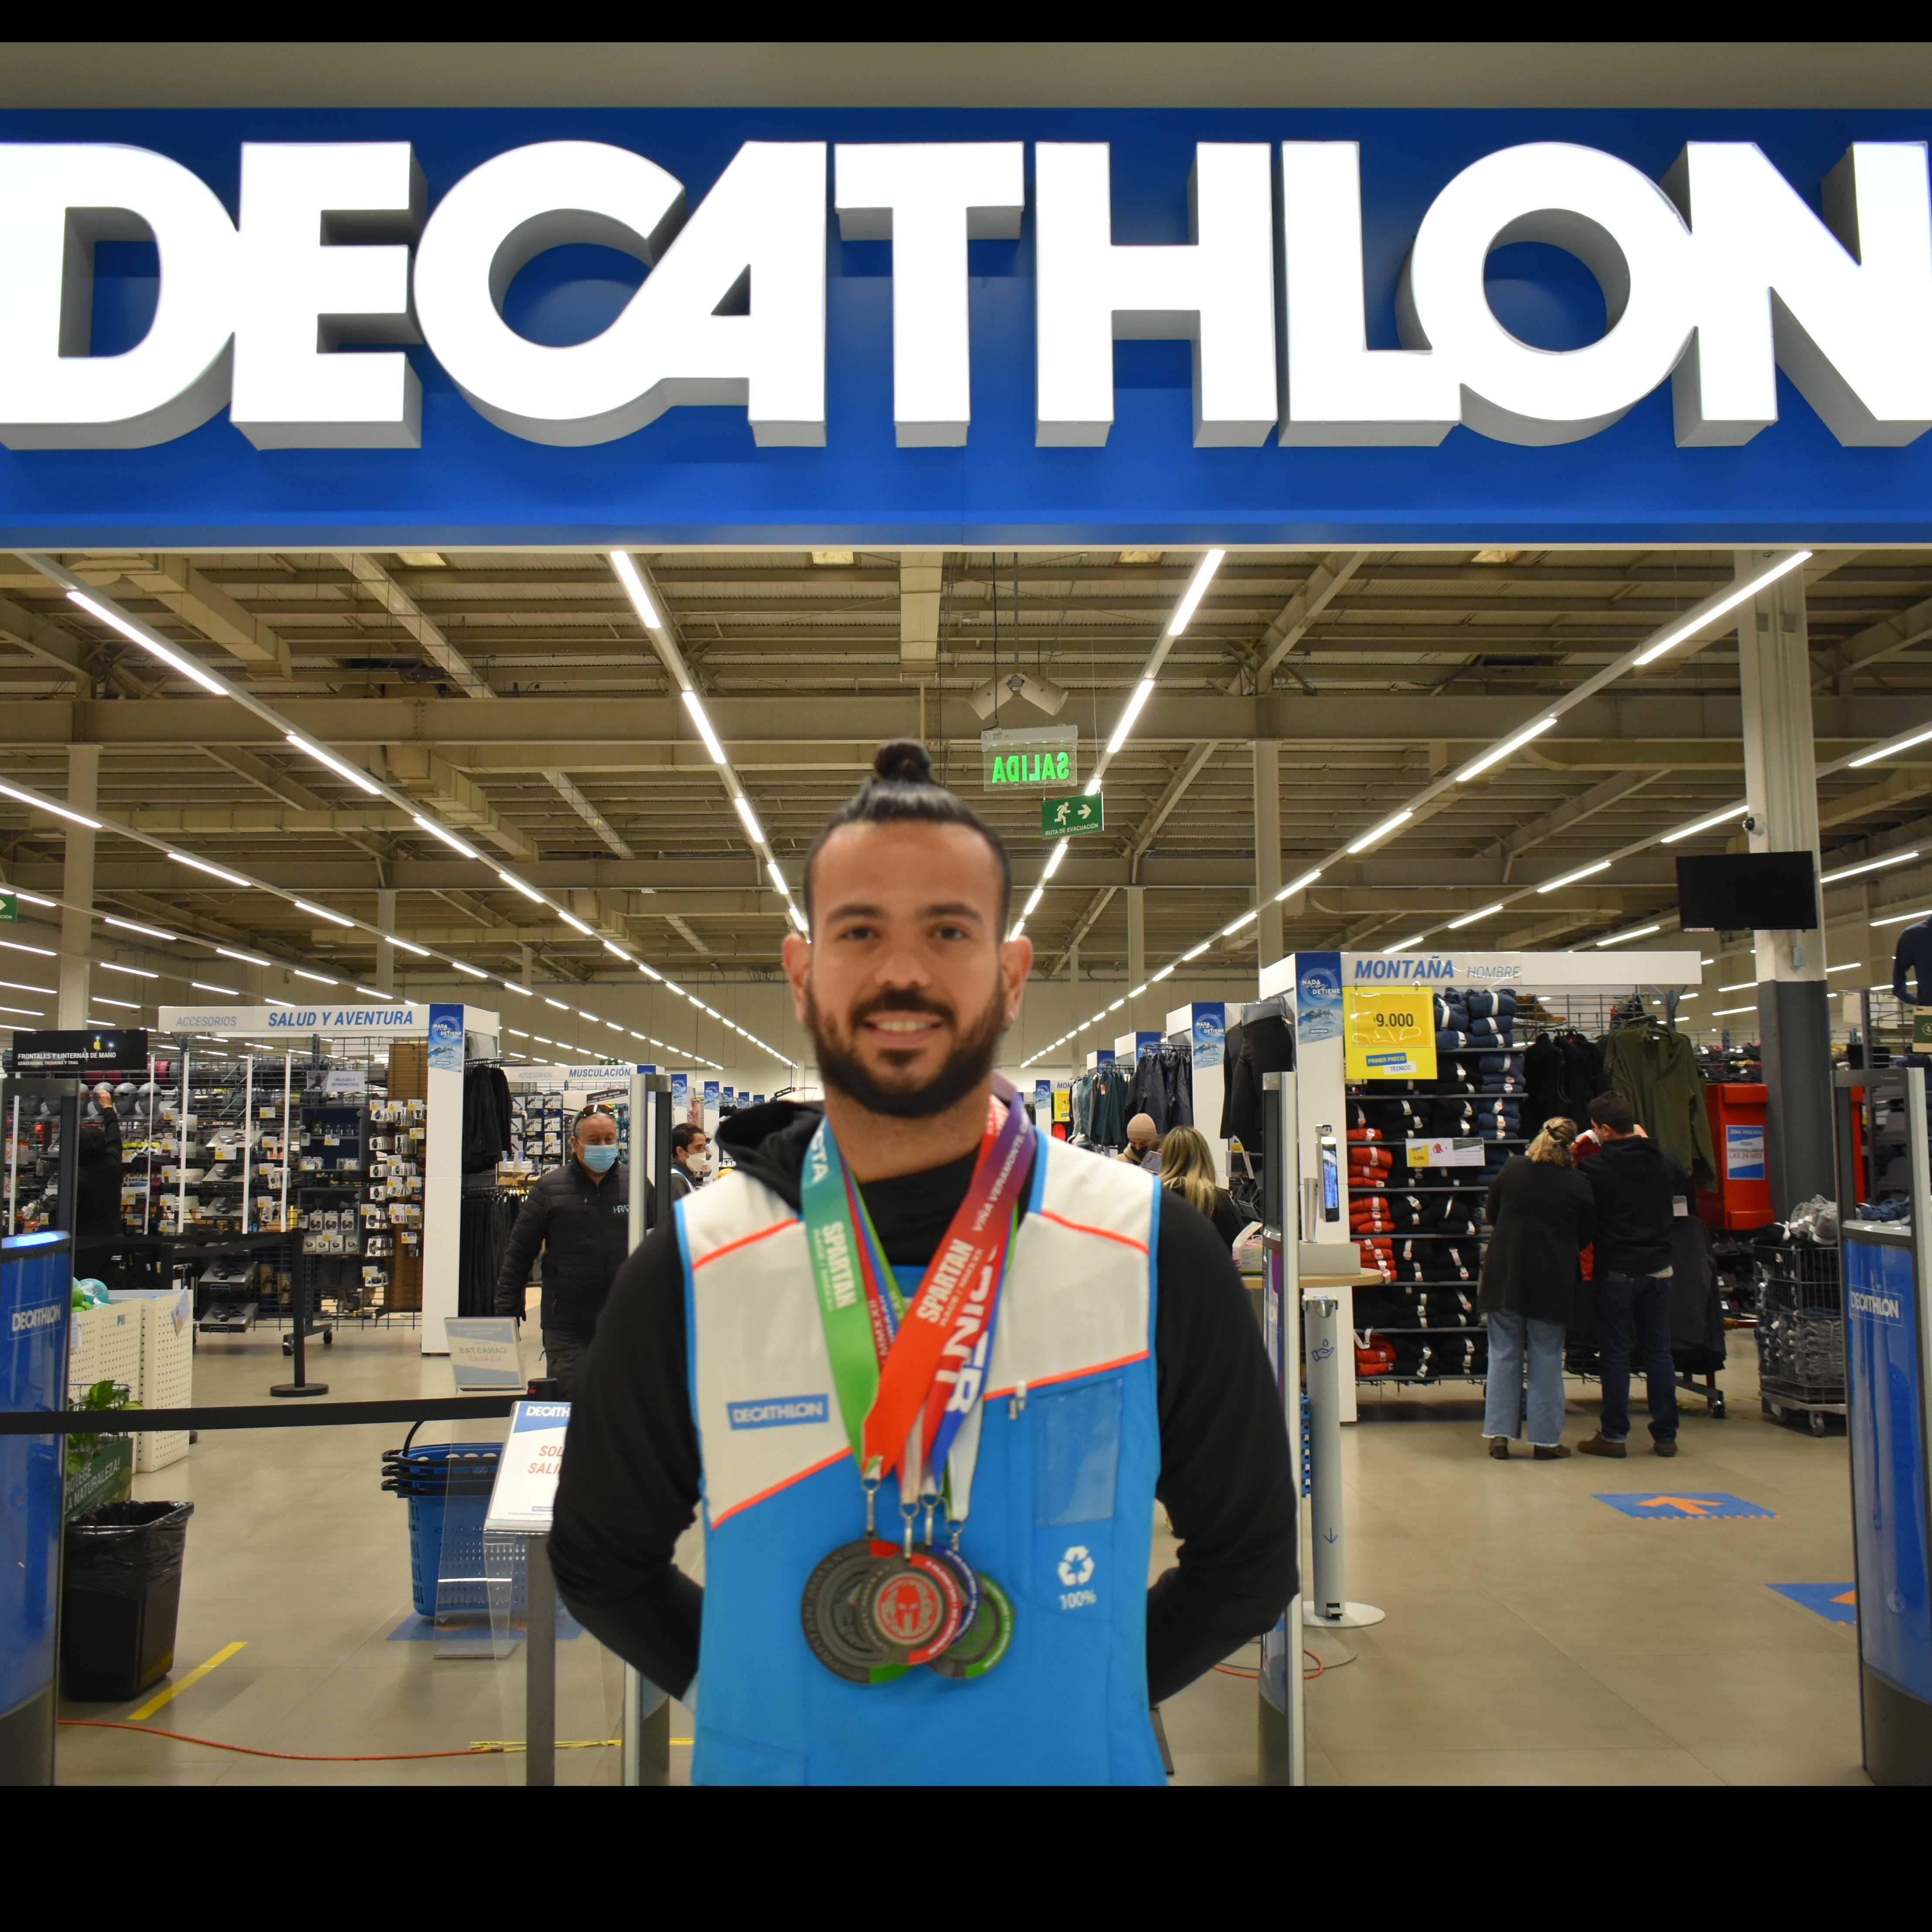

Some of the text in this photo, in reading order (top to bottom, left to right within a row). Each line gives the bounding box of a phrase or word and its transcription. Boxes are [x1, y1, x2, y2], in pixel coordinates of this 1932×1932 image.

[0, 140, 1932, 449] DECATHLON
[1067, 822, 1099, 832] EVACUACIÓN
[1354, 955, 1520, 979] MONTAÑA HOMBRE
[176, 1017, 237, 1026] ACCESORIOS
[269, 1010, 413, 1027] SALUD Y AVENTURA
[569, 1066, 631, 1077] MUSCULACIÓN
[822, 1221, 857, 1309] SPARTAN
[917, 1238, 975, 1323] SPARTAN
[1850, 1291, 1899, 1319] DECATHLON
[12, 1303, 61, 1332] DECATHLON
[527, 1406, 571, 1417] DECATH
[734, 1401, 823, 1423] DECATHLON
[538, 1446, 564, 1457] SOL
[527, 1462, 561, 1474] SALI
[65, 1462, 92, 1496] ROTEGE
[1060, 1589, 1096, 1610] 100%
